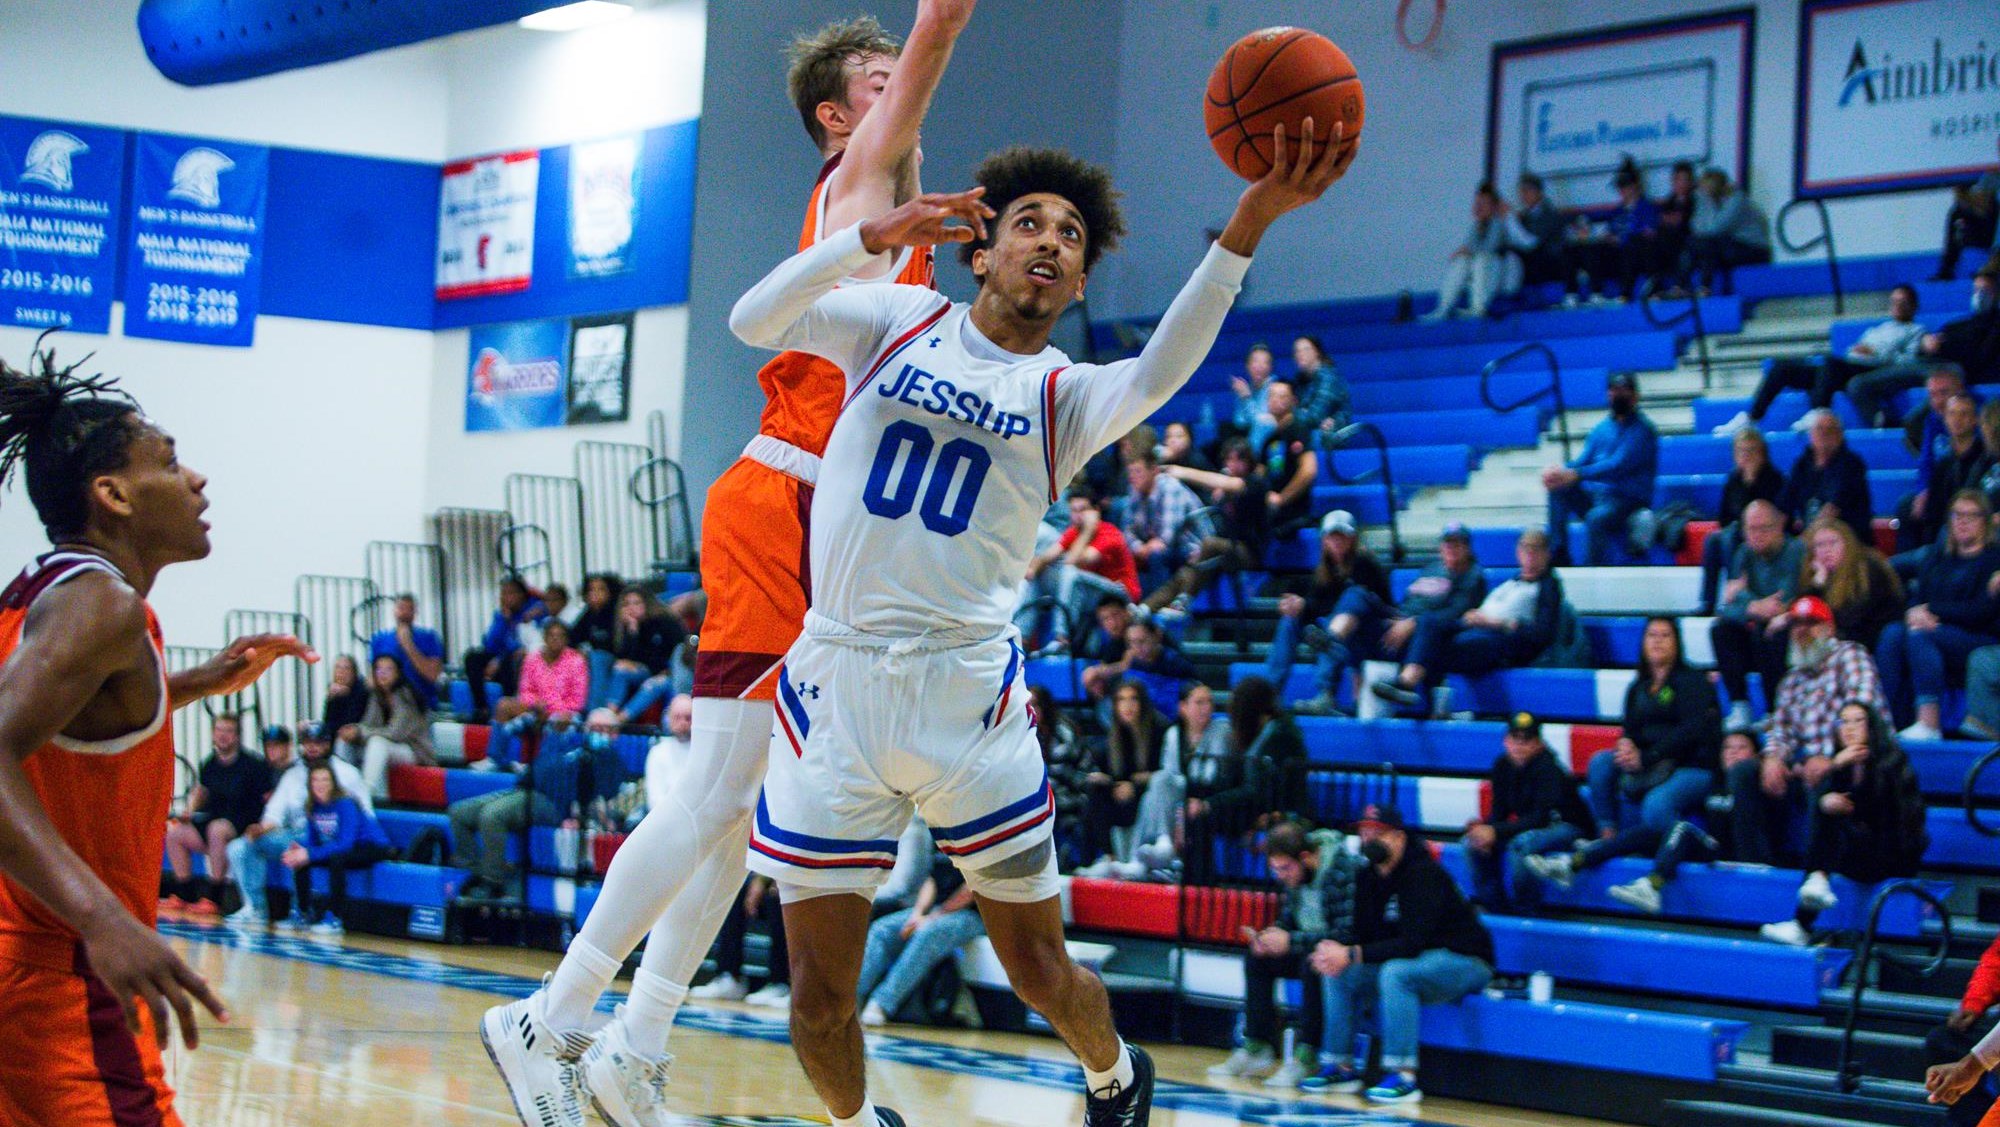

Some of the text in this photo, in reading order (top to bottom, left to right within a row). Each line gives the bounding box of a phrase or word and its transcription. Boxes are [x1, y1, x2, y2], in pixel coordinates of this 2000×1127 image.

[32, 193, 109, 216] BASKETBALL
[0, 213, 105, 240] AIA NATIONAL
[180, 209, 256, 232] BASKETBALL
[138, 232, 252, 259] NAIA NATIONAL
[144, 248, 247, 276] TOURNAMENT
[1, 268, 93, 295] 2015-2016
[148, 281, 239, 308] 2015-2016
[15, 306, 72, 325] SWEET 16
[878, 363, 1031, 440] JESSUP
[862, 419, 993, 537] 00
